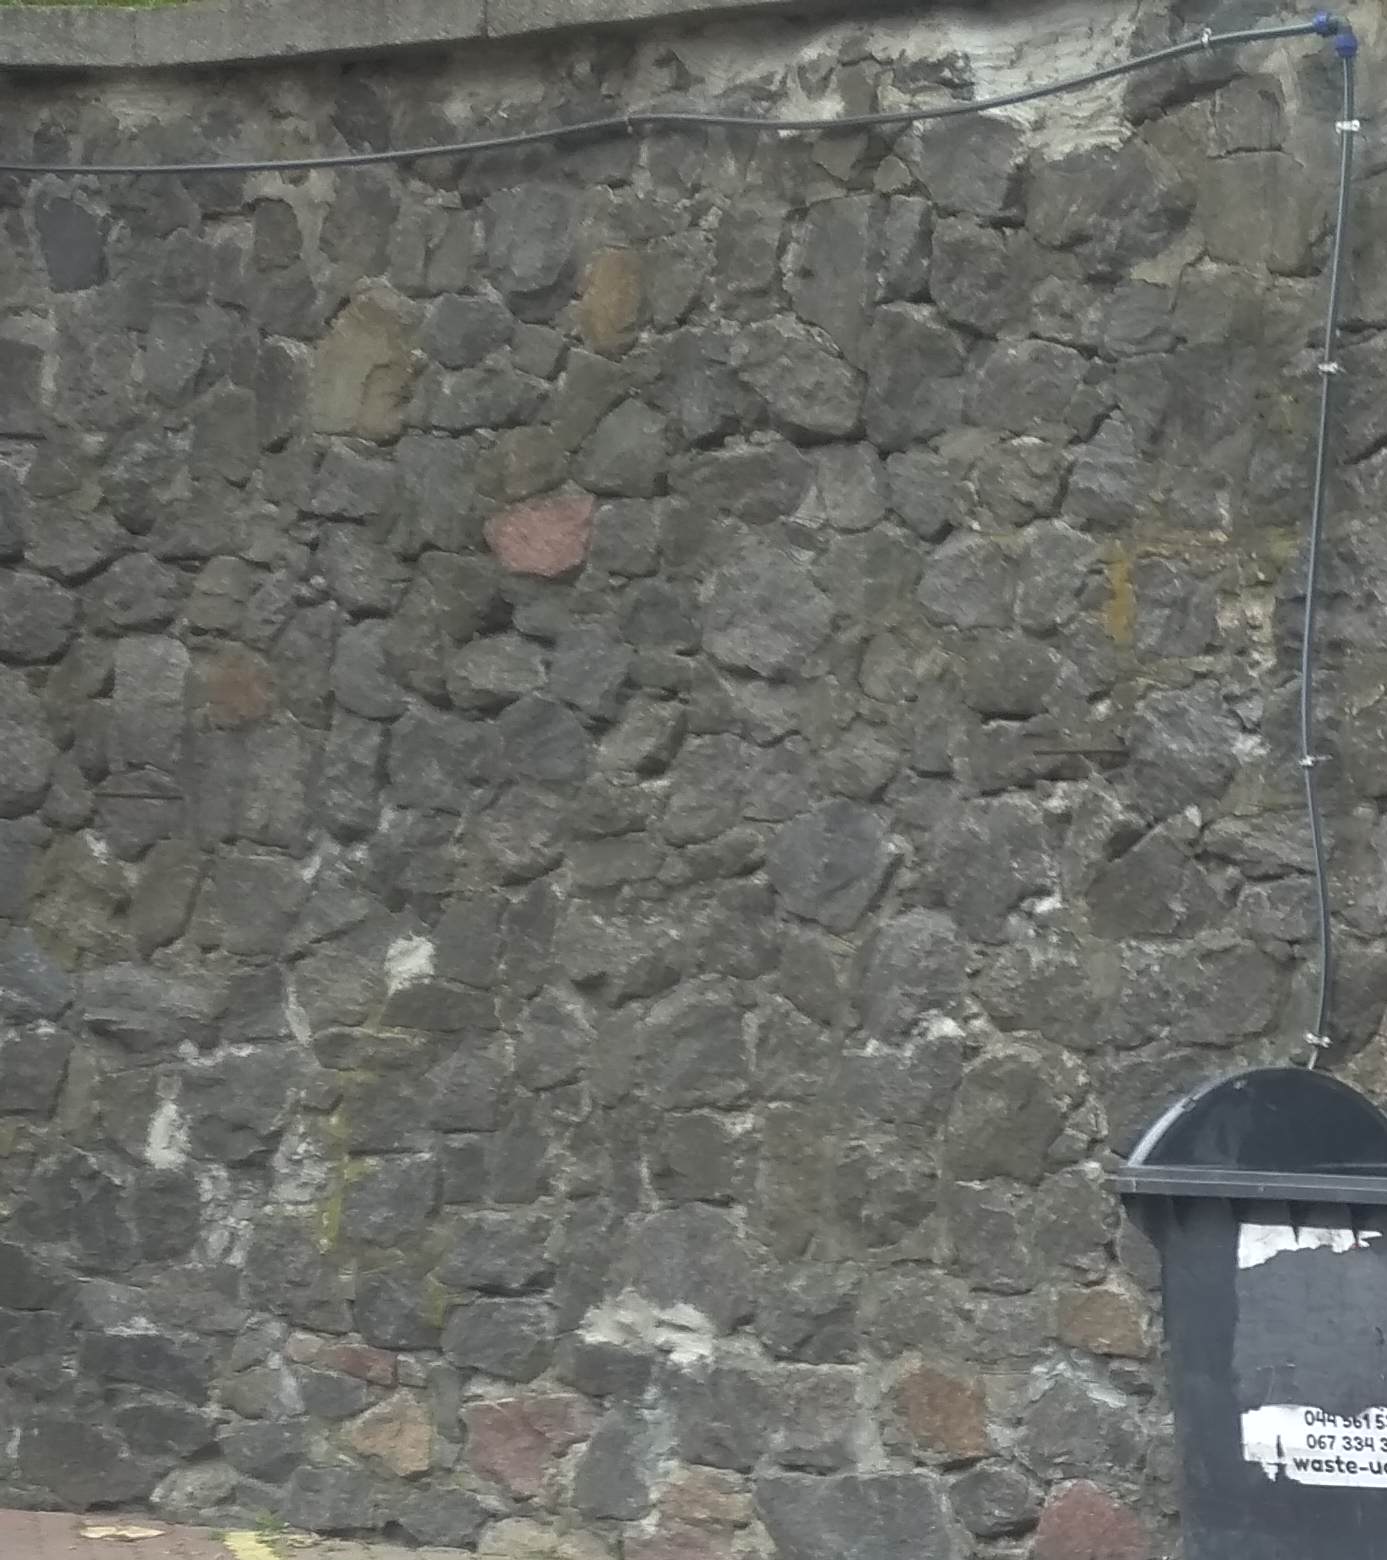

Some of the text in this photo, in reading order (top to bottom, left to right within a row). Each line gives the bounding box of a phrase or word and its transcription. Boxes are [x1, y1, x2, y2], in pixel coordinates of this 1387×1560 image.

[1304, 1410, 1337, 1427] 044
[1306, 1434, 1336, 1450] 067
[1342, 1436, 1375, 1452] 334
